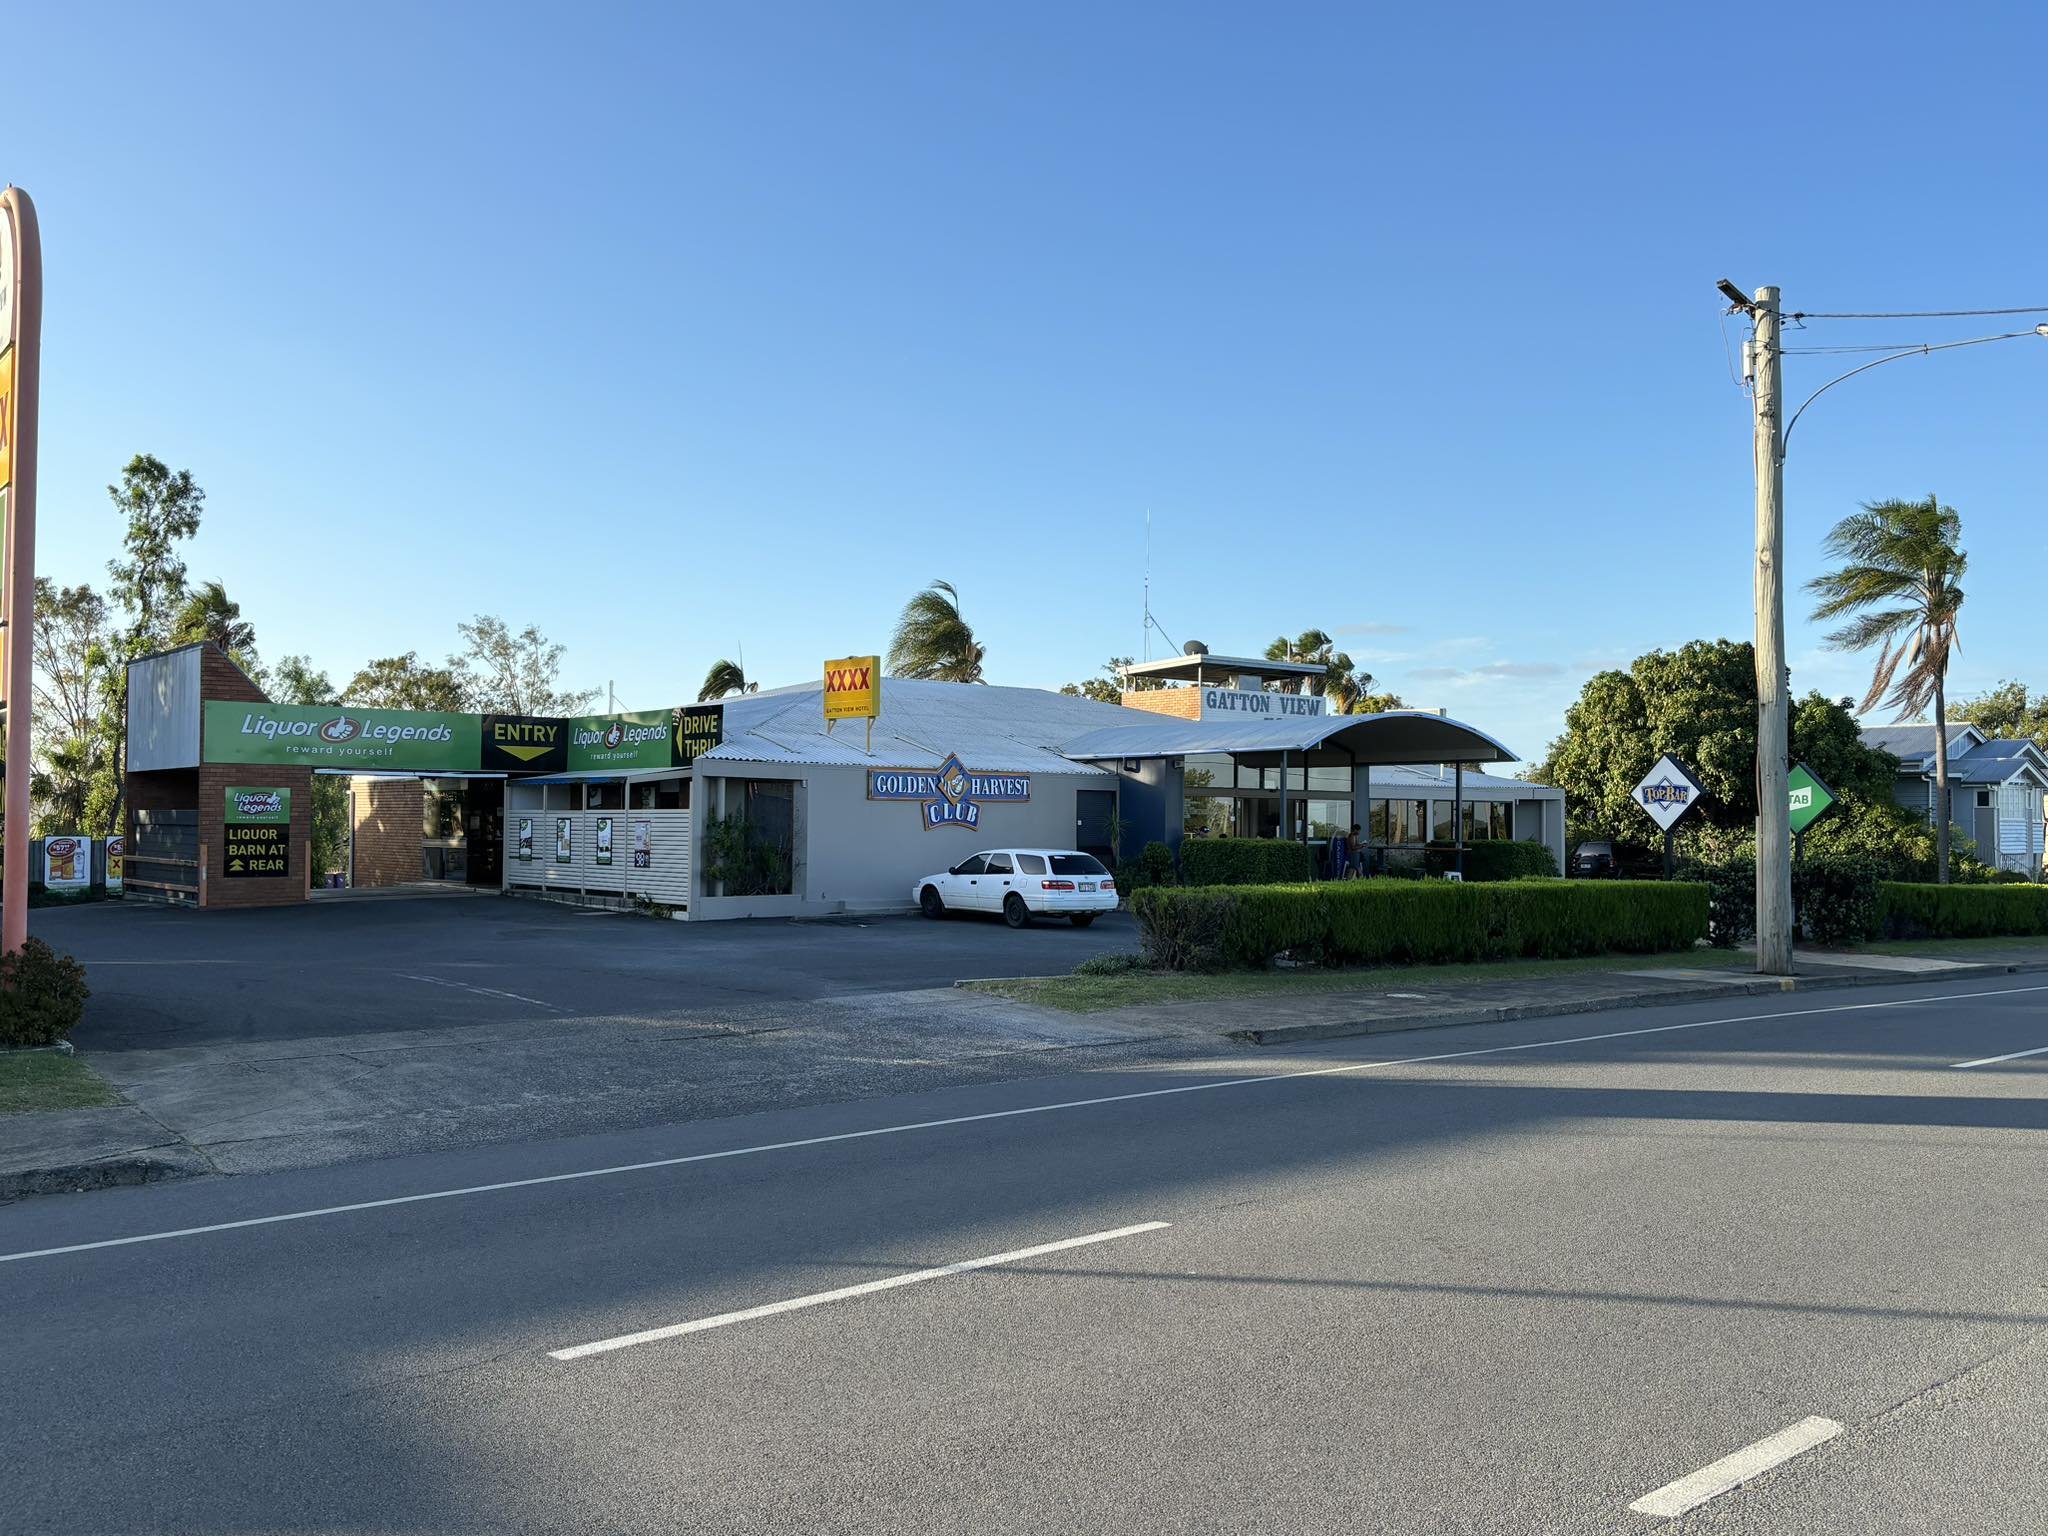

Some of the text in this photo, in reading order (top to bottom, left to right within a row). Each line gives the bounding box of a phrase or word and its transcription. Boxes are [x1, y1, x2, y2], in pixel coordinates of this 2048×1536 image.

[826, 667, 870, 692] XXXX
[1206, 691, 1321, 716] GATTON VIEW
[241, 714, 452, 744] Liquor Legends
[494, 723, 558, 742] ENTRY
[684, 714, 718, 735] DRIVE
[573, 721, 668, 749] Liquor Legends
[286, 745, 393, 756] reward yourself
[590, 750, 639, 761] reward yourself
[876, 774, 1030, 796] GOLDEN HARVEST
[233, 792, 267, 804] Liquor
[238, 802, 282, 813] Legends
[929, 801, 978, 824] CLUB
[229, 829, 278, 840] LIQUOR
[228, 844, 286, 856] BARN AT
[249, 859, 284, 871] REAR
